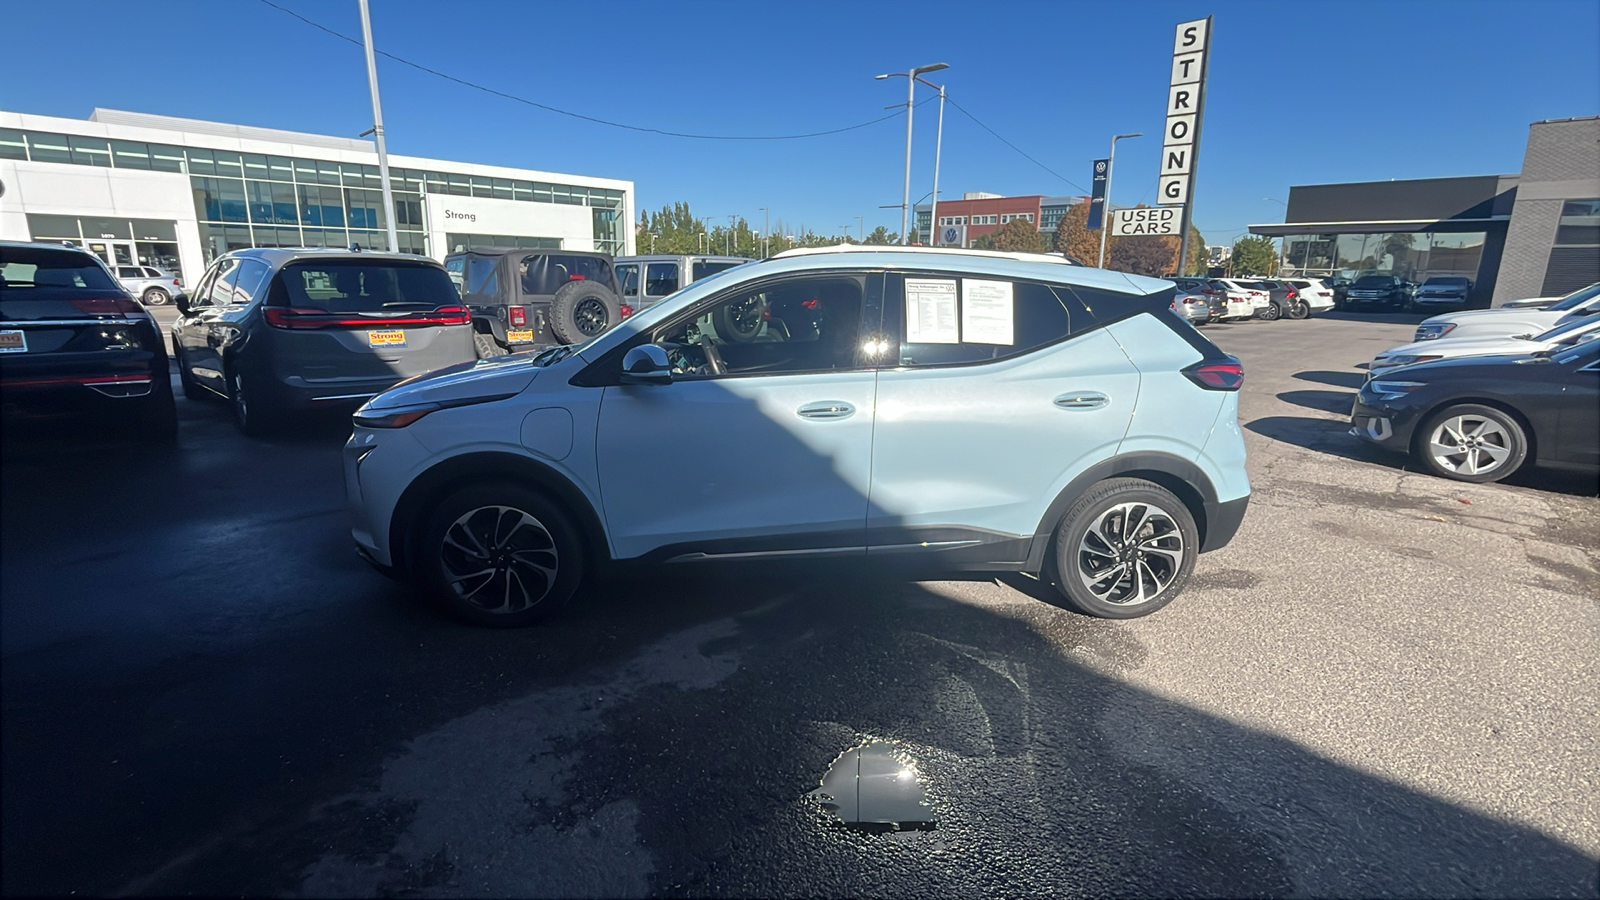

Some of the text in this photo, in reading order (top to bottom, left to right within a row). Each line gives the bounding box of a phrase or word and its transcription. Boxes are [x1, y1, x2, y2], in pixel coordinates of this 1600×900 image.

[1165, 26, 1197, 199] STRONG
[445, 209, 476, 222] Strong
[1121, 209, 1174, 222] USED
[1121, 222, 1172, 234] CARS
